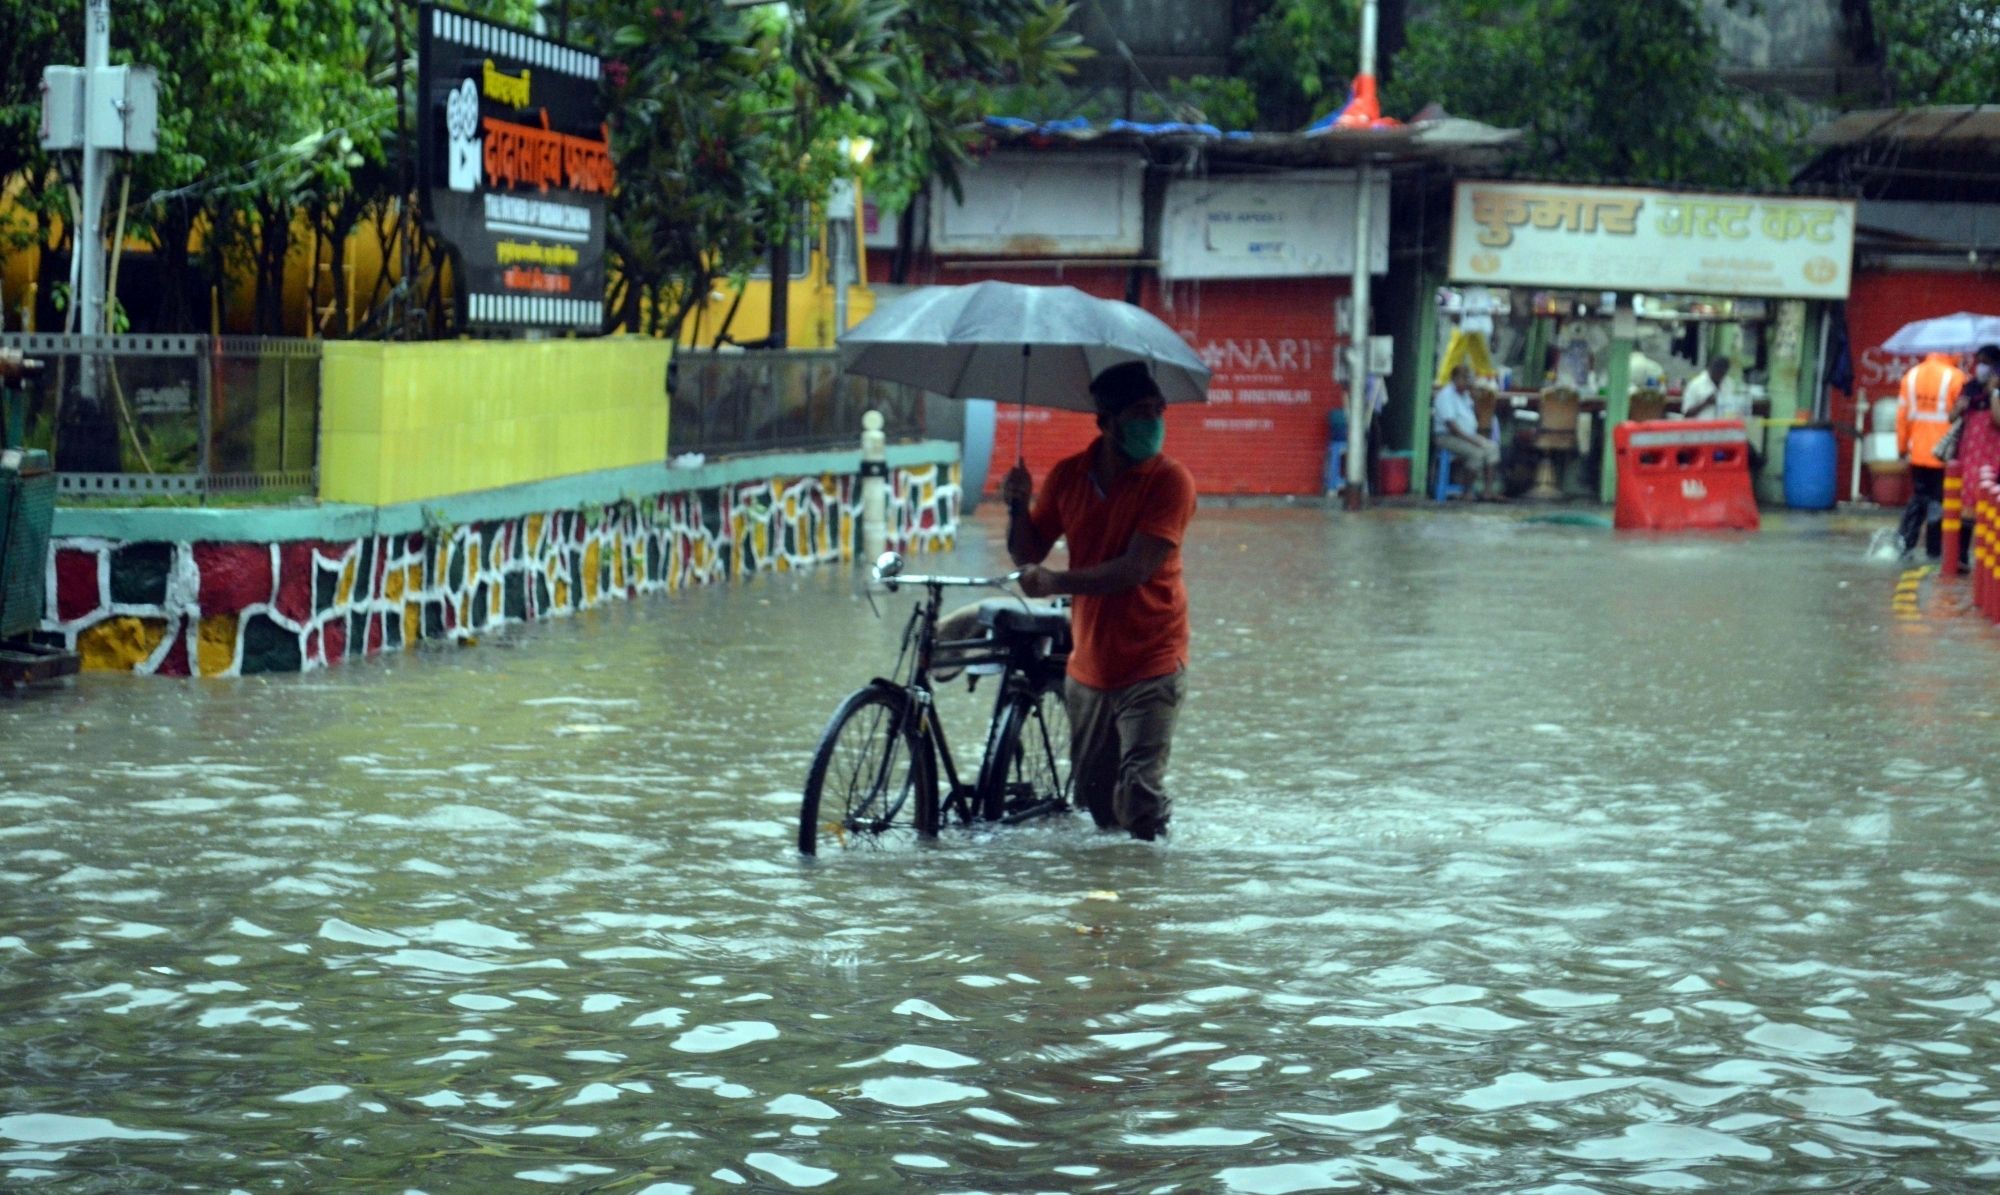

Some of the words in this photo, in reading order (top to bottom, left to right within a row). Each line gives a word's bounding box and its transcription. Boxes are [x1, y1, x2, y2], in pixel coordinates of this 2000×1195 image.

[1472, 190, 1644, 248] कुमार
[1654, 198, 1753, 240] जस्ट
[1762, 204, 1837, 244] कट
